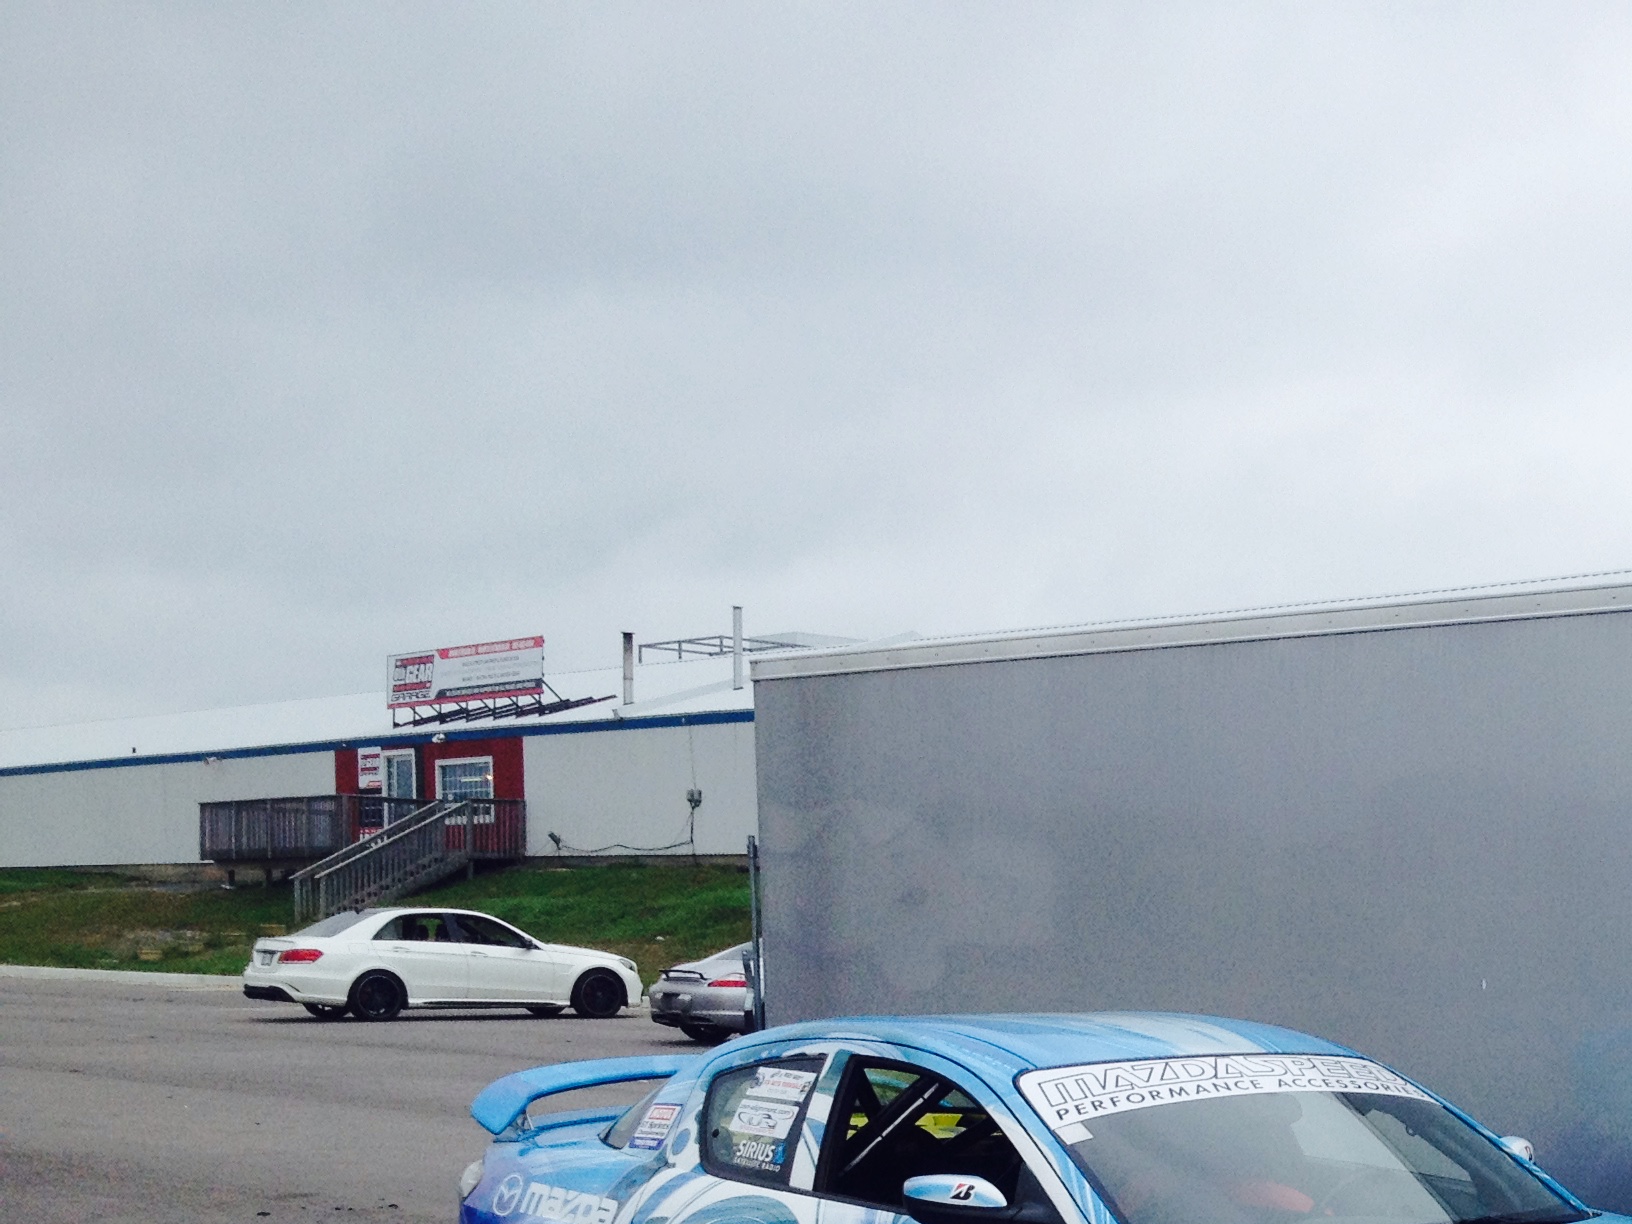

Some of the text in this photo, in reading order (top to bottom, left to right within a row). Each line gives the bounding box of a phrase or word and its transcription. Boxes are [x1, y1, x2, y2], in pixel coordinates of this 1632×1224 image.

[391, 690, 431, 701] GARAGE
[1038, 1056, 1408, 1107] MAZDASPEED
[1056, 1078, 1426, 1121] PERFORMANCE ACCESSORIES
[736, 1140, 775, 1162] SIRIUS
[761, 1160, 780, 1172] RADIO
